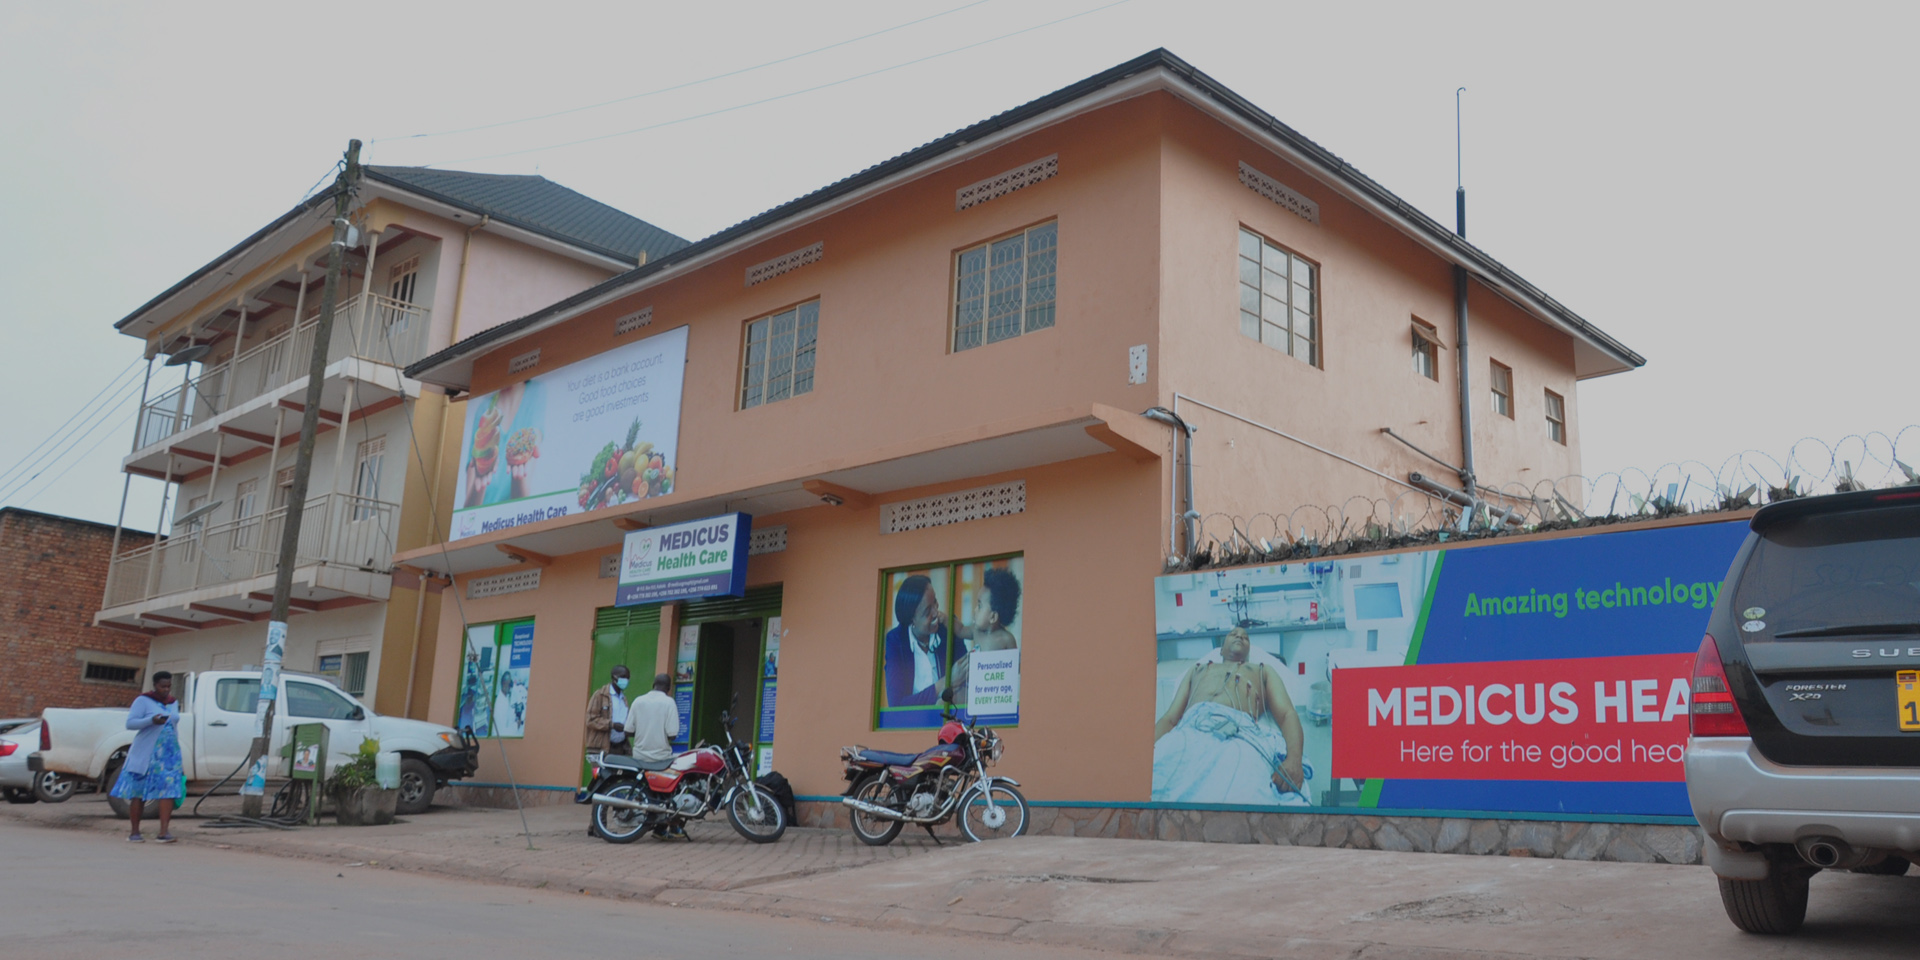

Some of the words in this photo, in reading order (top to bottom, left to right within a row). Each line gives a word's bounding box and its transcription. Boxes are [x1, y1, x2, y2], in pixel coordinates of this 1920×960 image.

[567, 380, 581, 392] Your
[582, 374, 596, 388] diet
[603, 371, 610, 381] a
[611, 362, 630, 378] bank
[579, 388, 599, 405] Good
[600, 382, 617, 398] food
[618, 375, 647, 393] choices
[573, 411, 584, 423] are
[585, 401, 606, 422] good
[607, 392, 648, 412] investments
[481, 516, 515, 534] Medicus
[516, 508, 545, 526] Health
[547, 505, 568, 519] Care
[659, 523, 729, 552] MEDICUS
[656, 551, 696, 571] Health
[699, 549, 728, 565] Care
[1464, 587, 1568, 619] Amazing
[1575, 577, 1725, 610] technology
[977, 660, 1013, 670] Personalized
[984, 672, 1005, 681] CARE
[975, 685, 983, 693] for
[984, 685, 999, 694] every
[1000, 685, 1013, 694] age,
[975, 696, 992, 705] EVERY
[994, 695, 1013, 704] STAGE
[1785, 683, 1847, 691] FORESTER
[1367, 681, 1579, 727] MEDICUS
[1594, 677, 1691, 723] HEA
[1400, 739, 1454, 762] Here
[1460, 739, 1492, 762] for
[1500, 739, 1542, 763] the
[1549, 739, 1621, 769] good
